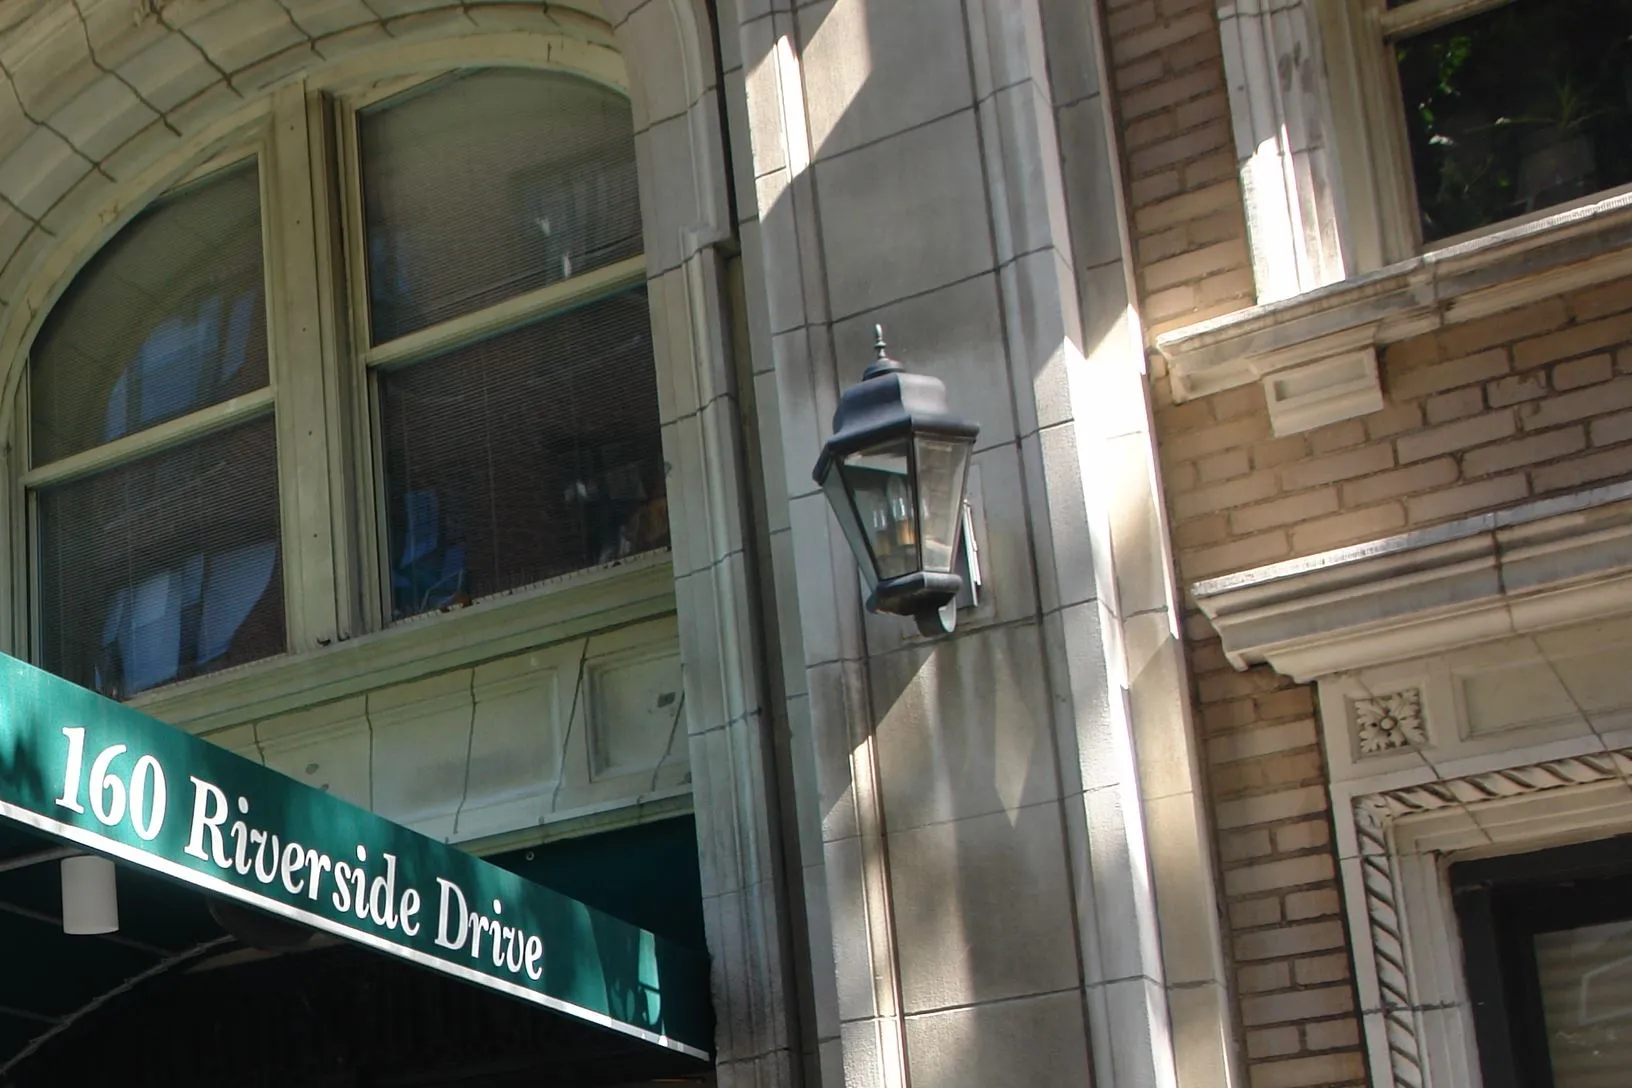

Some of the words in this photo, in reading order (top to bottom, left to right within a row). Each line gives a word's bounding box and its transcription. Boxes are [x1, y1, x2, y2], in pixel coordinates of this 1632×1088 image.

[54, 726, 167, 842] 160
[184, 776, 420, 937] Riverside
[434, 876, 543, 981] Drive
